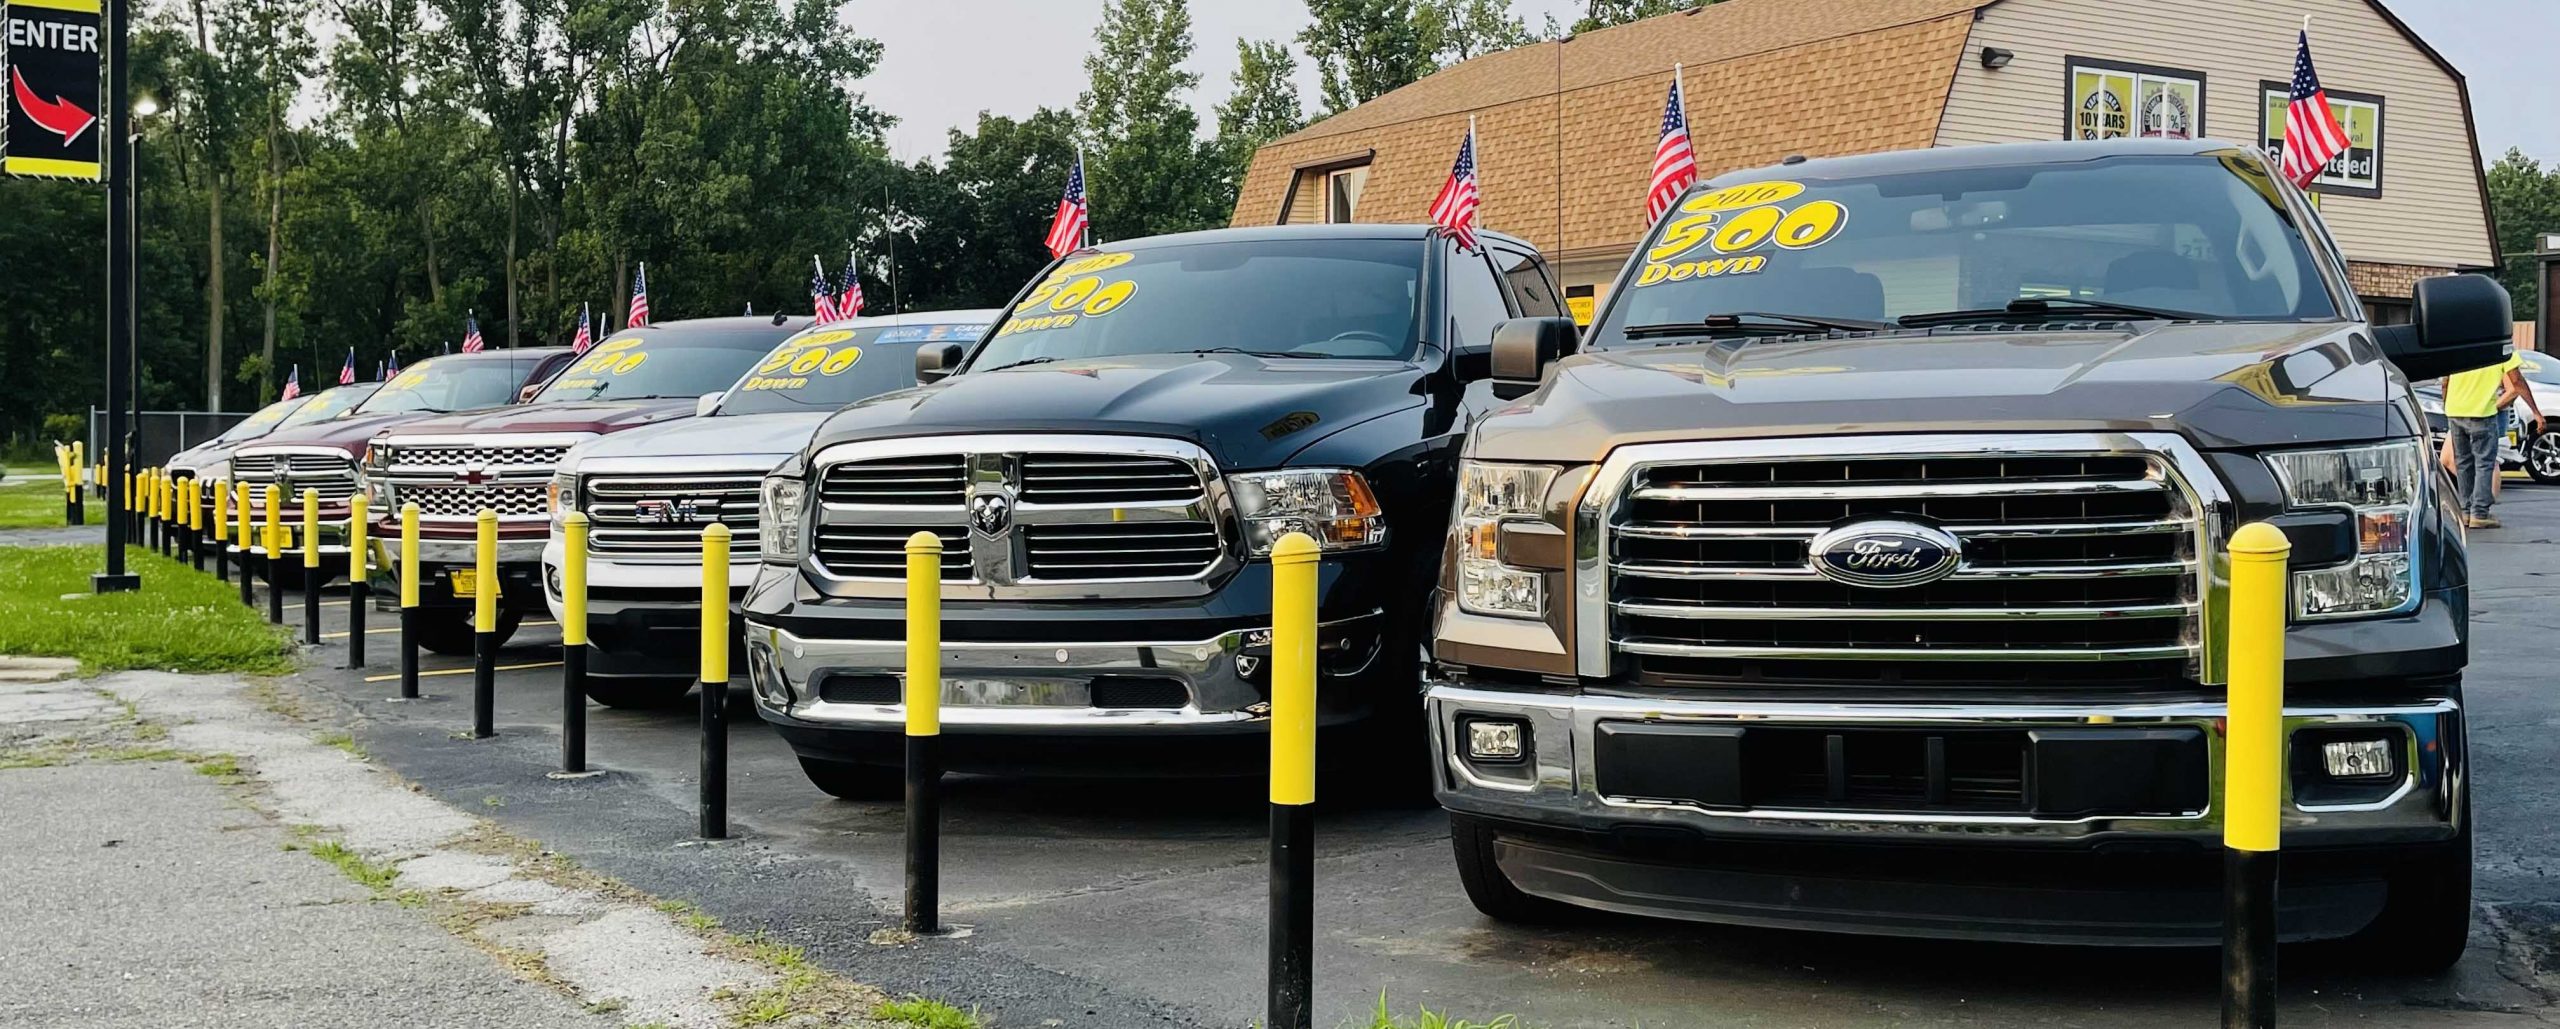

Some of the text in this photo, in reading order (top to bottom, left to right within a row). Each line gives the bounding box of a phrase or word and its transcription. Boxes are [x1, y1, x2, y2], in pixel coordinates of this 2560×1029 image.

[9, 19, 98, 53] ENTER
[2080, 112, 2125, 129] 10 YARS
[2152, 114, 2179, 129] 10%
[1697, 187, 1780, 210] 2016
[1648, 200, 1849, 263] 500
[1635, 255, 1767, 288] Down
[1012, 275, 1139, 317] 500
[996, 314, 1078, 337] Down
[758, 346, 863, 376] 500
[742, 377, 809, 391] Down
[635, 499, 719, 523] GMC
[1847, 539, 1922, 569] Ford
